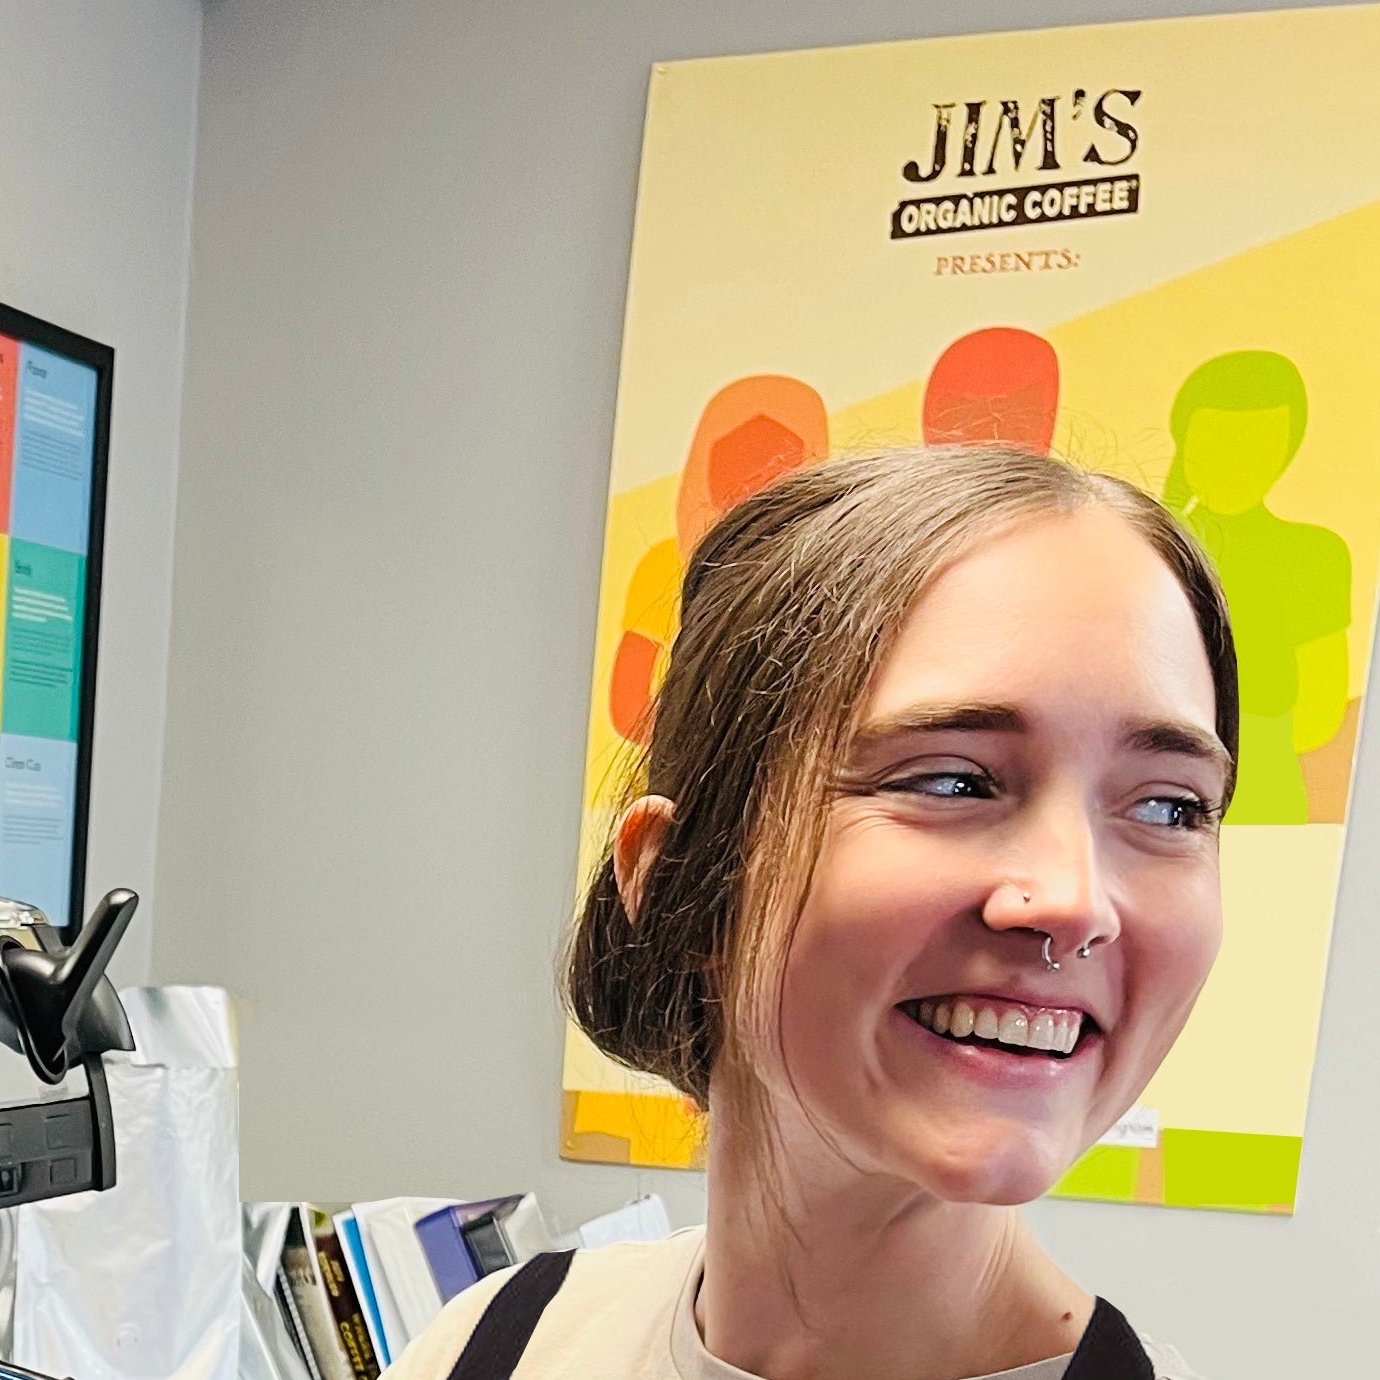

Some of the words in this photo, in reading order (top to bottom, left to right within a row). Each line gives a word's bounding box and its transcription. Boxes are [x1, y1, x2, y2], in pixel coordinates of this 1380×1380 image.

[902, 88, 1141, 182] JIM'S
[901, 193, 1018, 234] ORGANIC
[1024, 180, 1130, 220] COFFEE
[934, 249, 1082, 276] PRESENTS:
